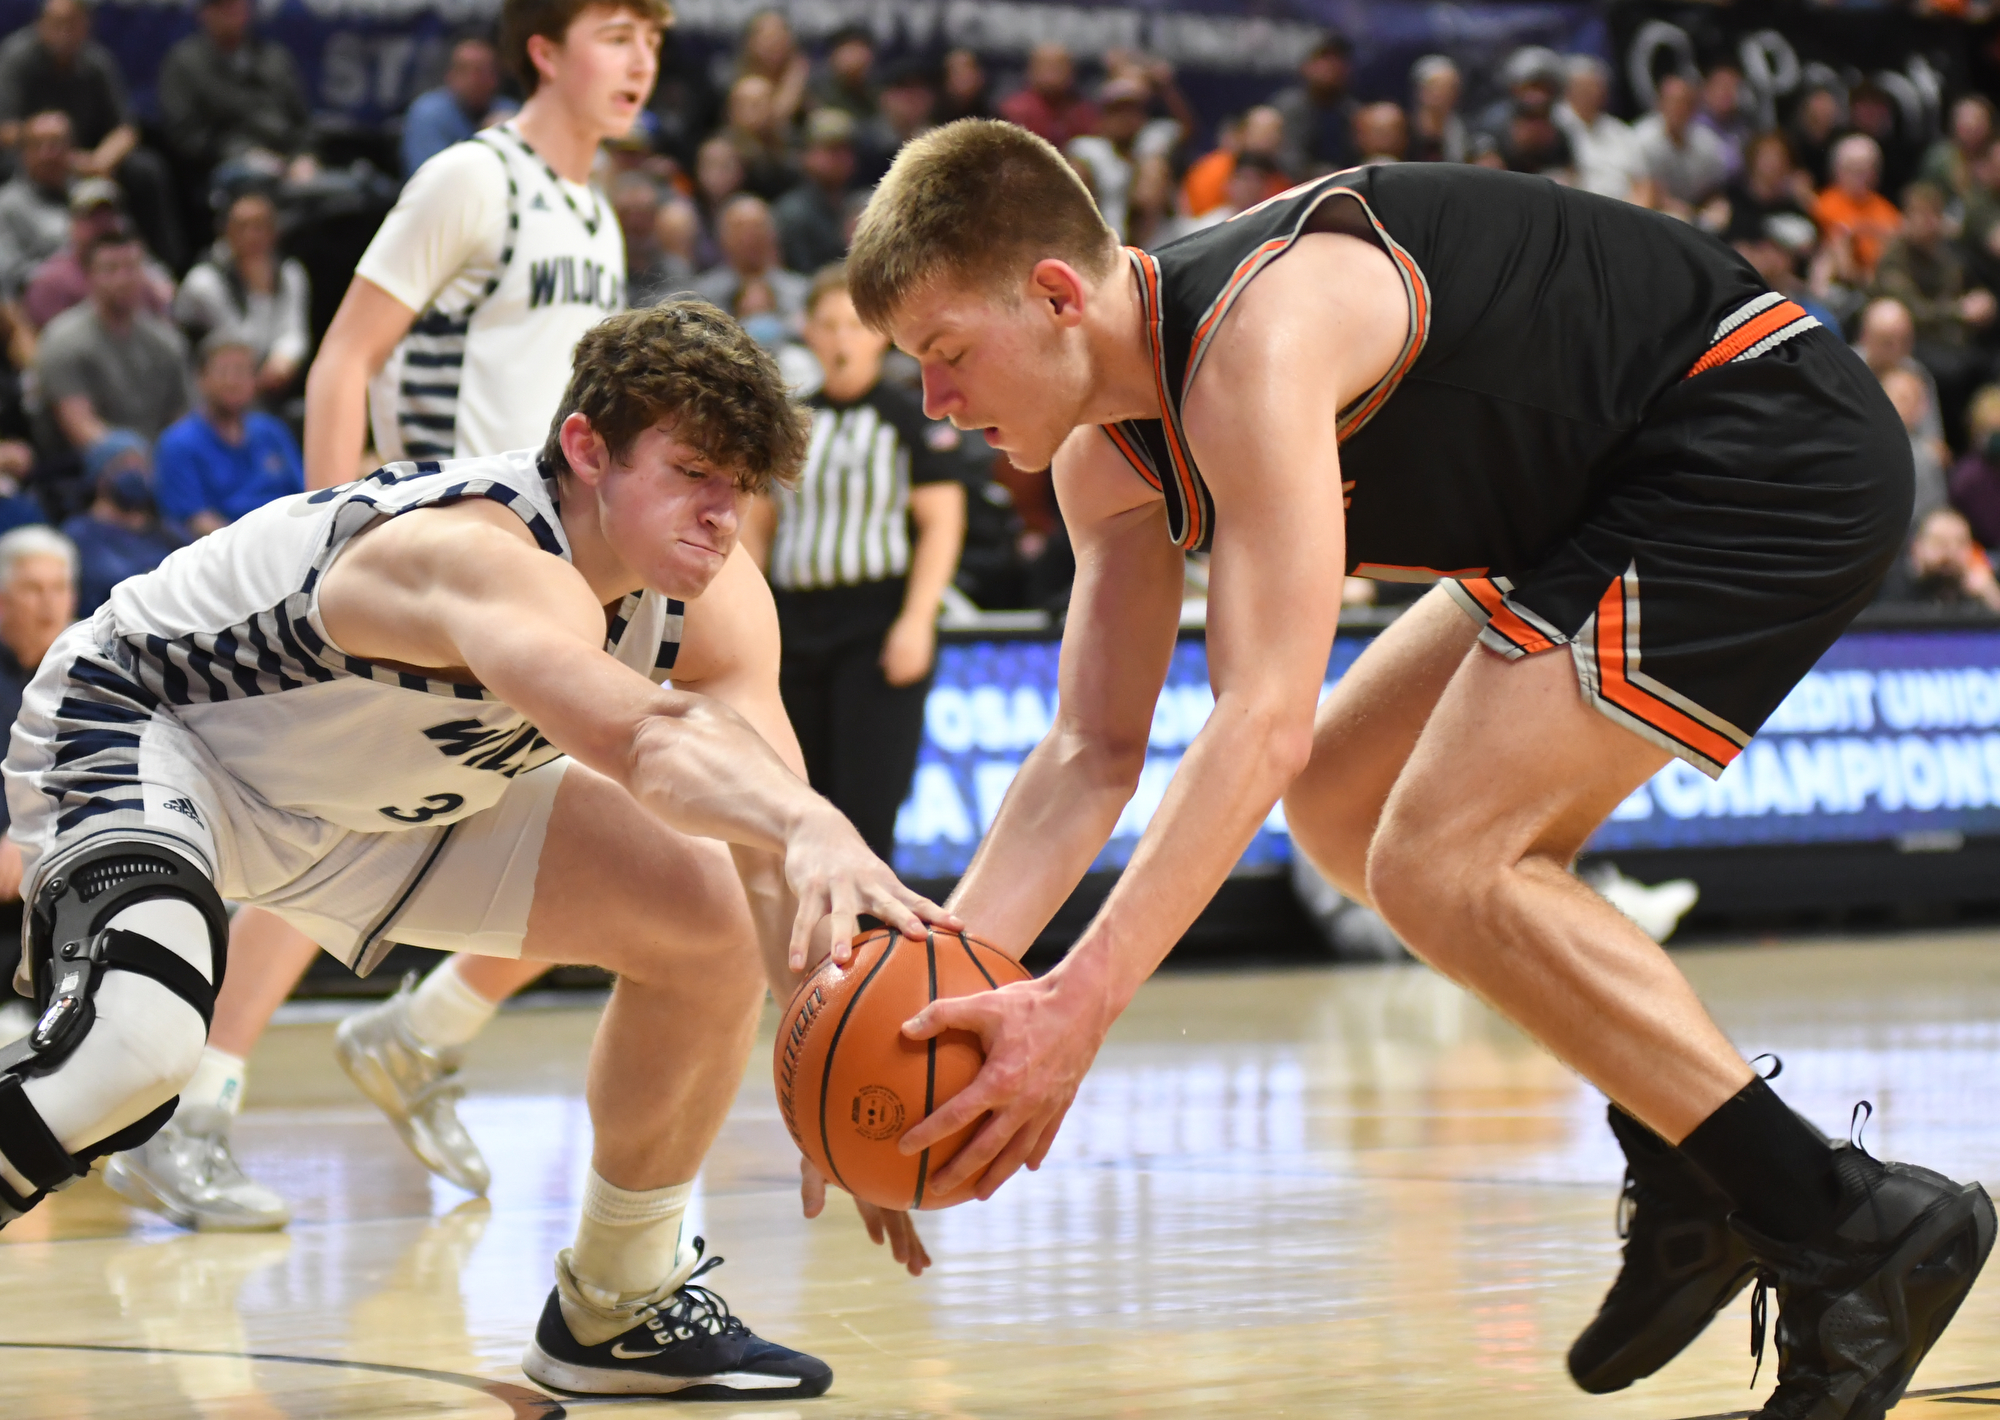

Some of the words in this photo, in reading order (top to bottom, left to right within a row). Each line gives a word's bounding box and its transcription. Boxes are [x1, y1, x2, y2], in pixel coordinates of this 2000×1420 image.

[926, 685, 1061, 752] OSA
[1878, 667, 2000, 730] UNIO
[163, 802, 205, 831] adidas
[379, 792, 465, 823] 3
